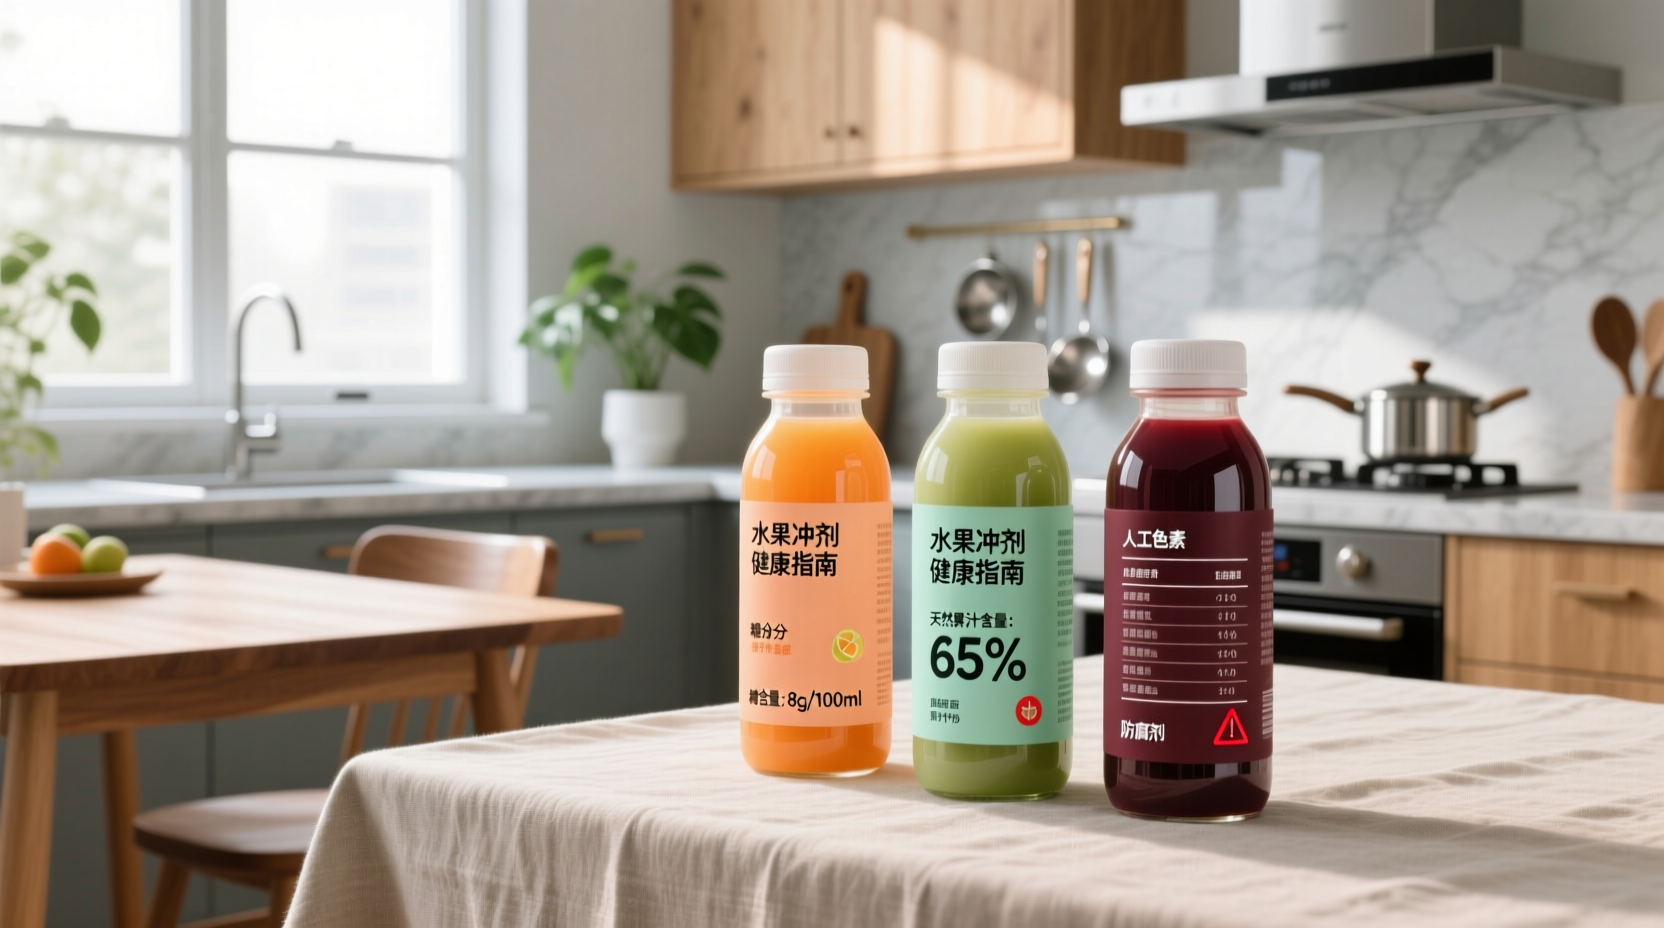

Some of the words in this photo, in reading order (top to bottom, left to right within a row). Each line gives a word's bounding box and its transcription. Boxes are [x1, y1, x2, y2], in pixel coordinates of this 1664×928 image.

[751, 520, 839, 548] 水果冲剂
[930, 527, 1025, 555] 水果冲剂
[1122, 528, 1186, 549] 人工色素
[751, 550, 838, 577] 健康指南
[930, 558, 1024, 586] 健康指南
[930, 635, 1027, 682] 65%
